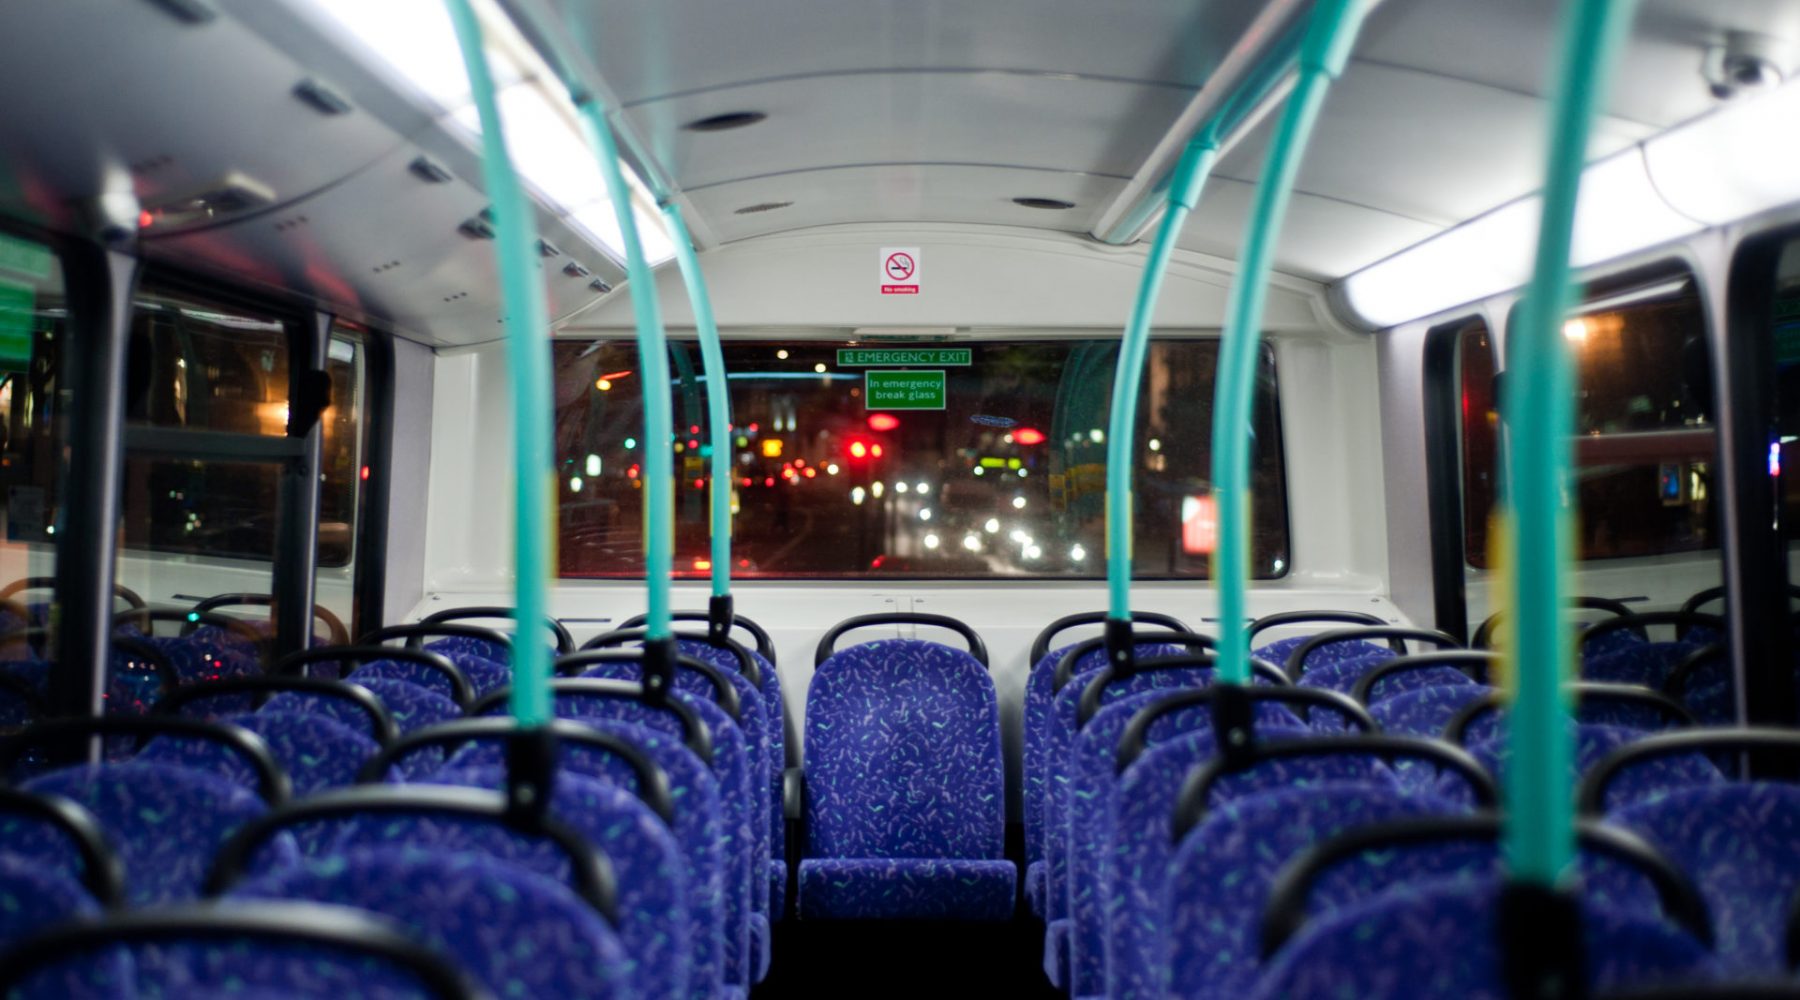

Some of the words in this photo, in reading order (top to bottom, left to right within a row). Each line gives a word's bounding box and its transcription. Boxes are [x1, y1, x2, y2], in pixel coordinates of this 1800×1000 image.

[857, 352, 935, 362] EMERGENCY
[939, 352, 968, 362] EXIT
[869, 379, 880, 388] In
[882, 380, 942, 390] emergency
[875, 390, 905, 399] break
[908, 390, 936, 401] glass
